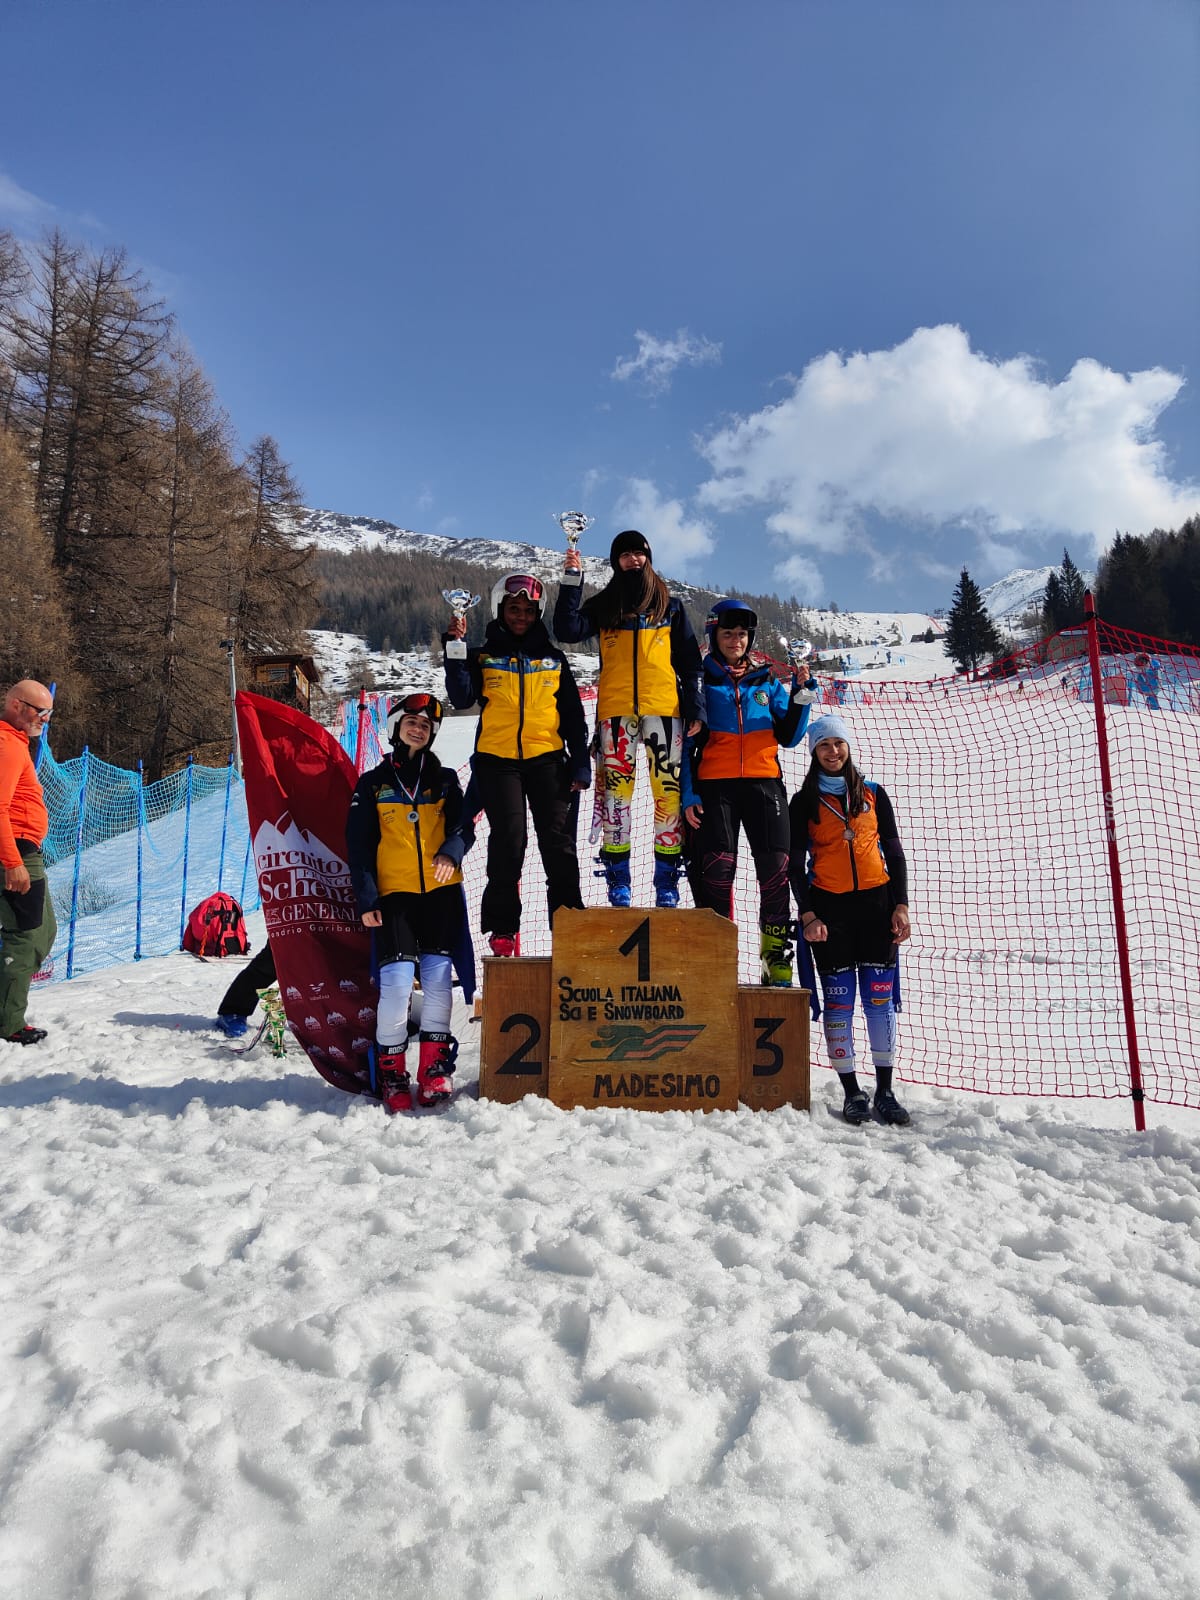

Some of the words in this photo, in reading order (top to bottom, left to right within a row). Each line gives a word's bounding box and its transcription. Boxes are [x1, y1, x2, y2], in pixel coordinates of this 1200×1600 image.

[260, 868, 356, 904] Schena
[282, 902, 361, 922] GENERAL
[271, 926, 302, 938] ondrio
[765, 924, 787, 936] RC4
[618, 916, 651, 982] 1
[621, 985, 682, 1002] ITALIANA
[587, 1006, 598, 1021] E
[604, 1002, 684, 1020] SNOWBOARD
[495, 1013, 543, 1076] 2
[752, 1018, 787, 1077] 3
[593, 1072, 721, 1098] MADESIMO
